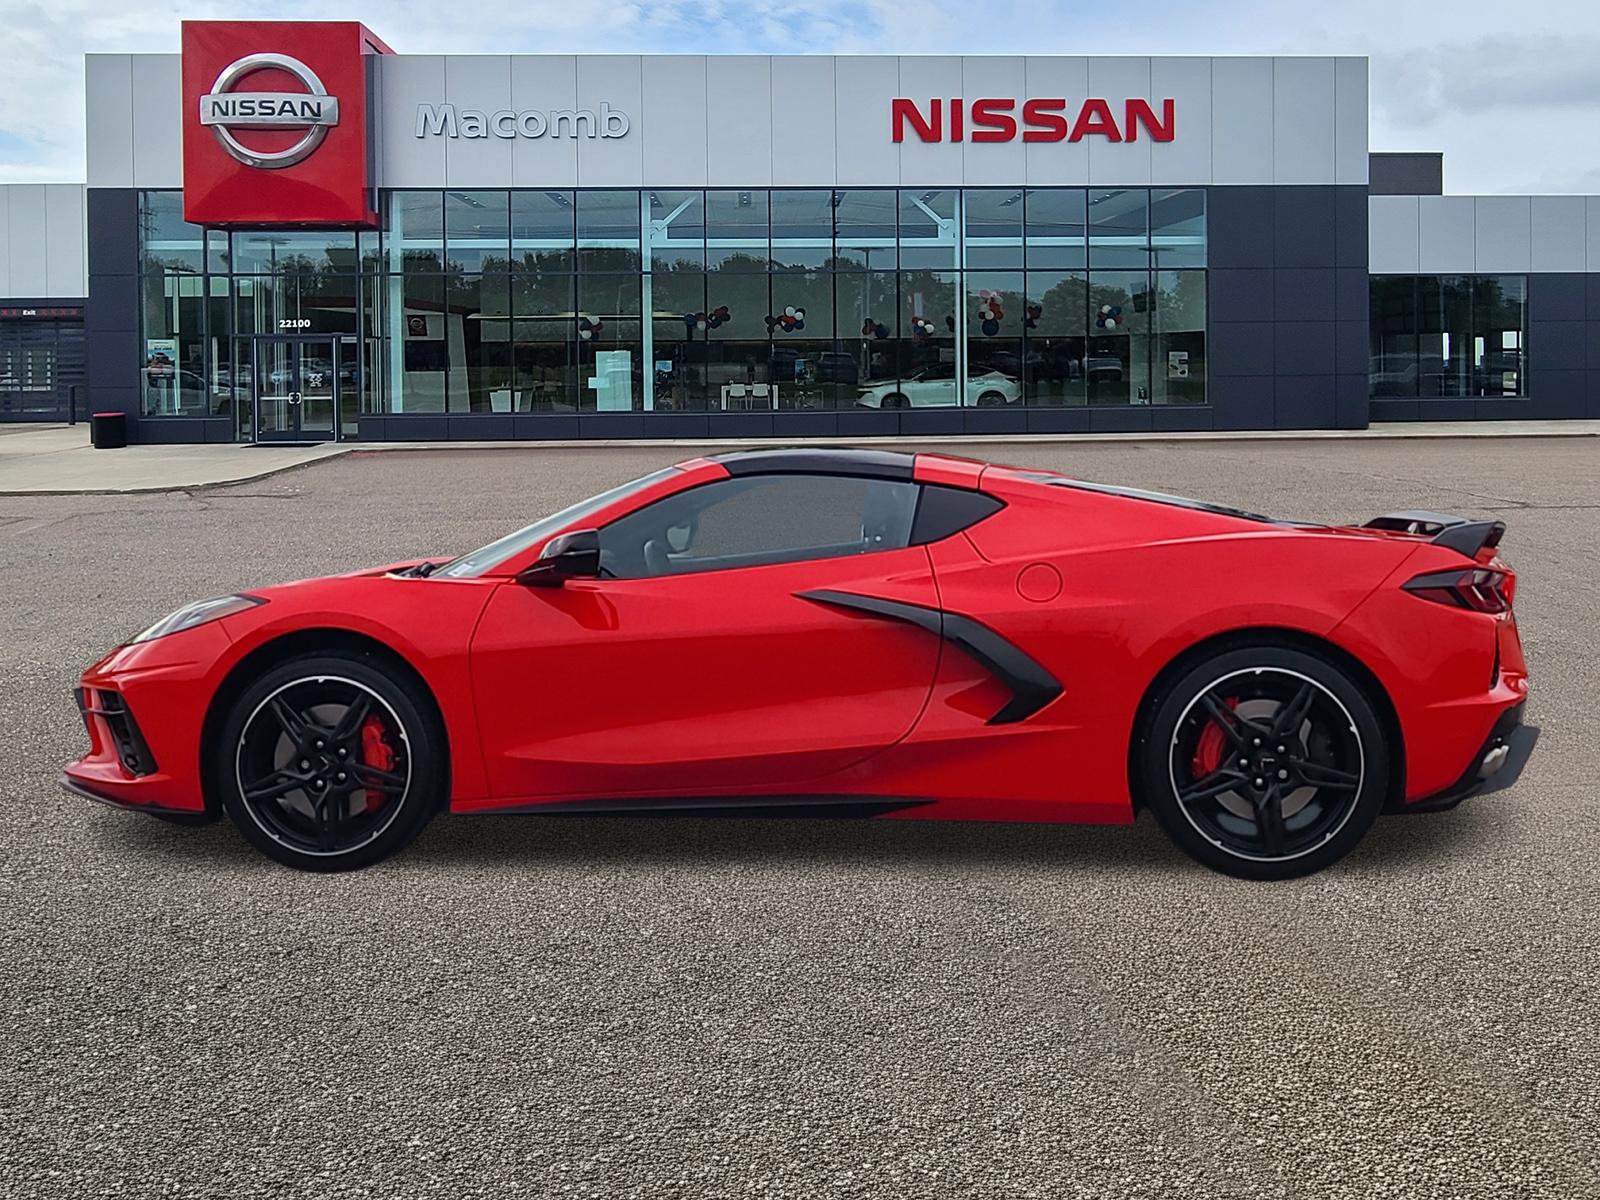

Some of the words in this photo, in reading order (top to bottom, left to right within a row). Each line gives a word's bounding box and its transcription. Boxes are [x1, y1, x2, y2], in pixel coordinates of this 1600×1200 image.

[211, 100, 322, 118] NISSAN
[415, 102, 630, 139] Macomb
[891, 97, 1175, 143] NISSAN
[279, 319, 311, 328] 22100
